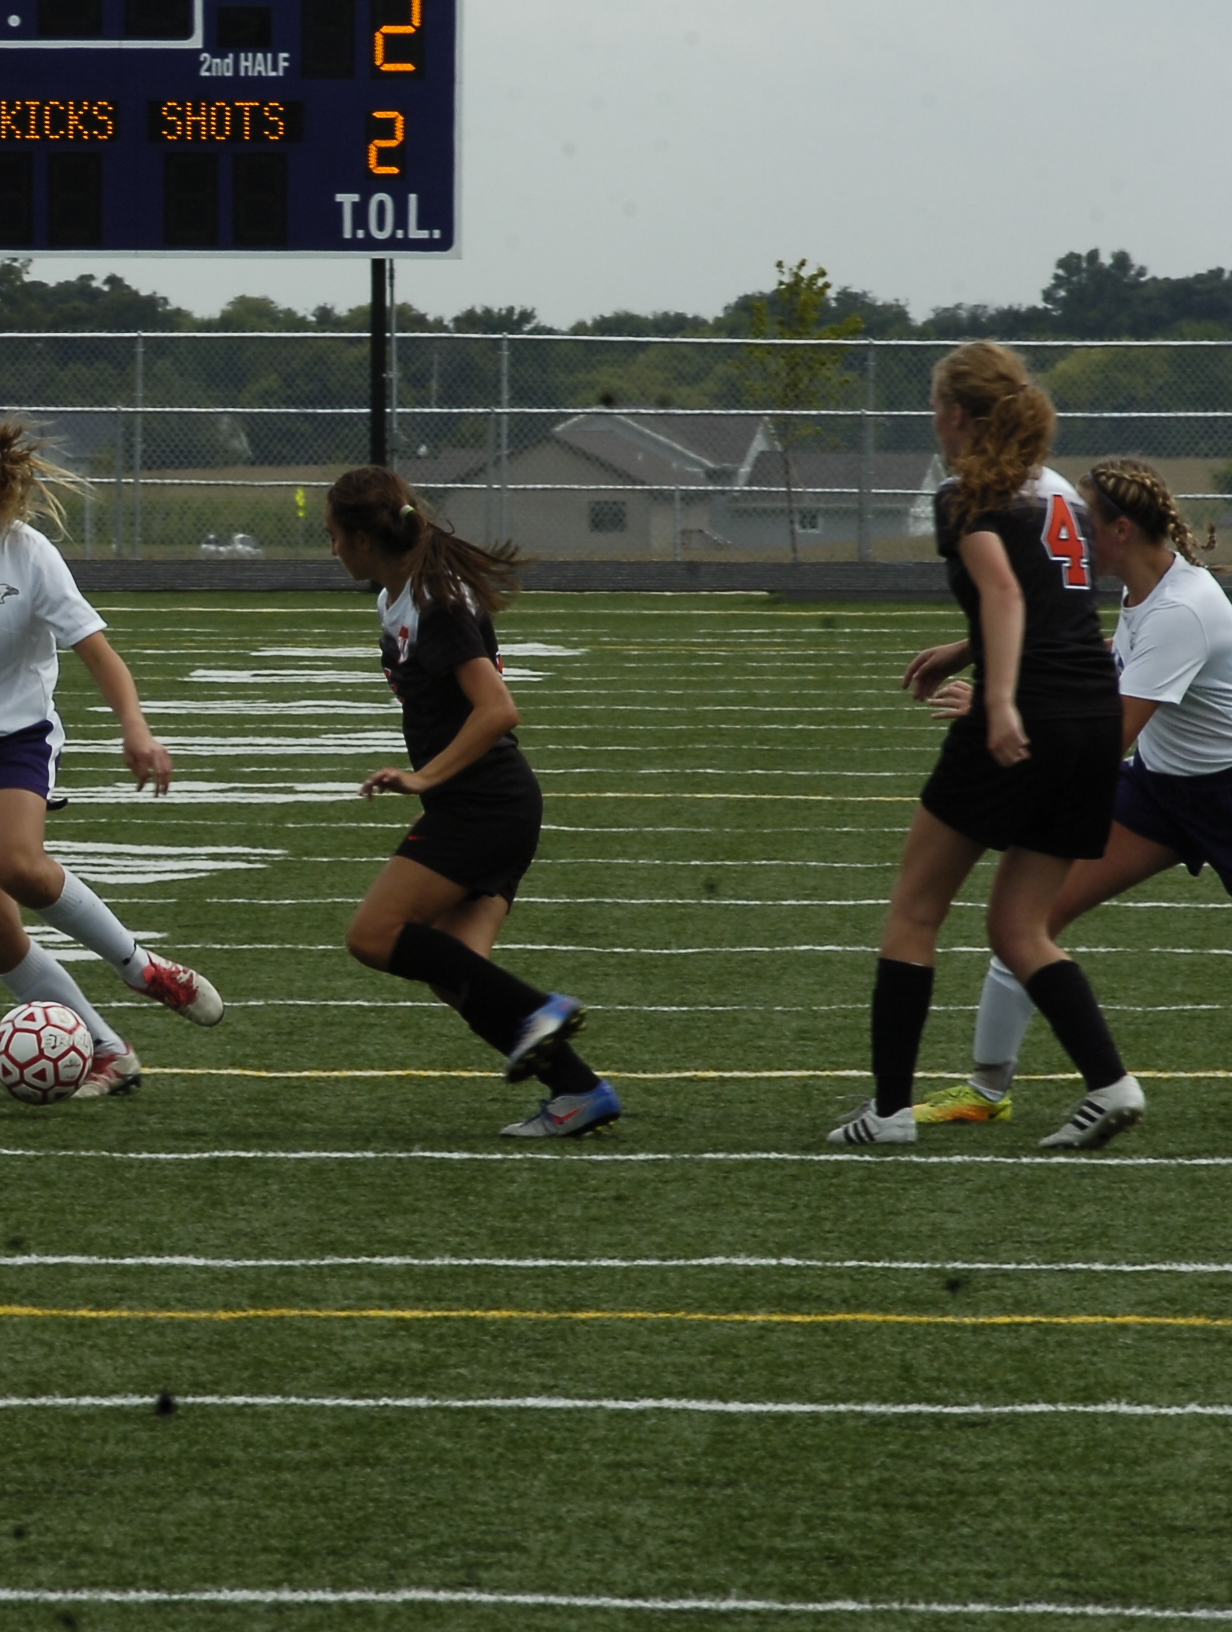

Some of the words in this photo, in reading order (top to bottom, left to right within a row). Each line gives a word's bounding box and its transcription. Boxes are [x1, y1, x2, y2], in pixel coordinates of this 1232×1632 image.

[199, 53, 233, 76] 2nd
[239, 53, 290, 77] HALF
[162, 102, 285, 140] SHOTS
[368, 111, 404, 174] 2
[335, 193, 441, 239] T.O.L.
[1041, 493, 1092, 590] 4
